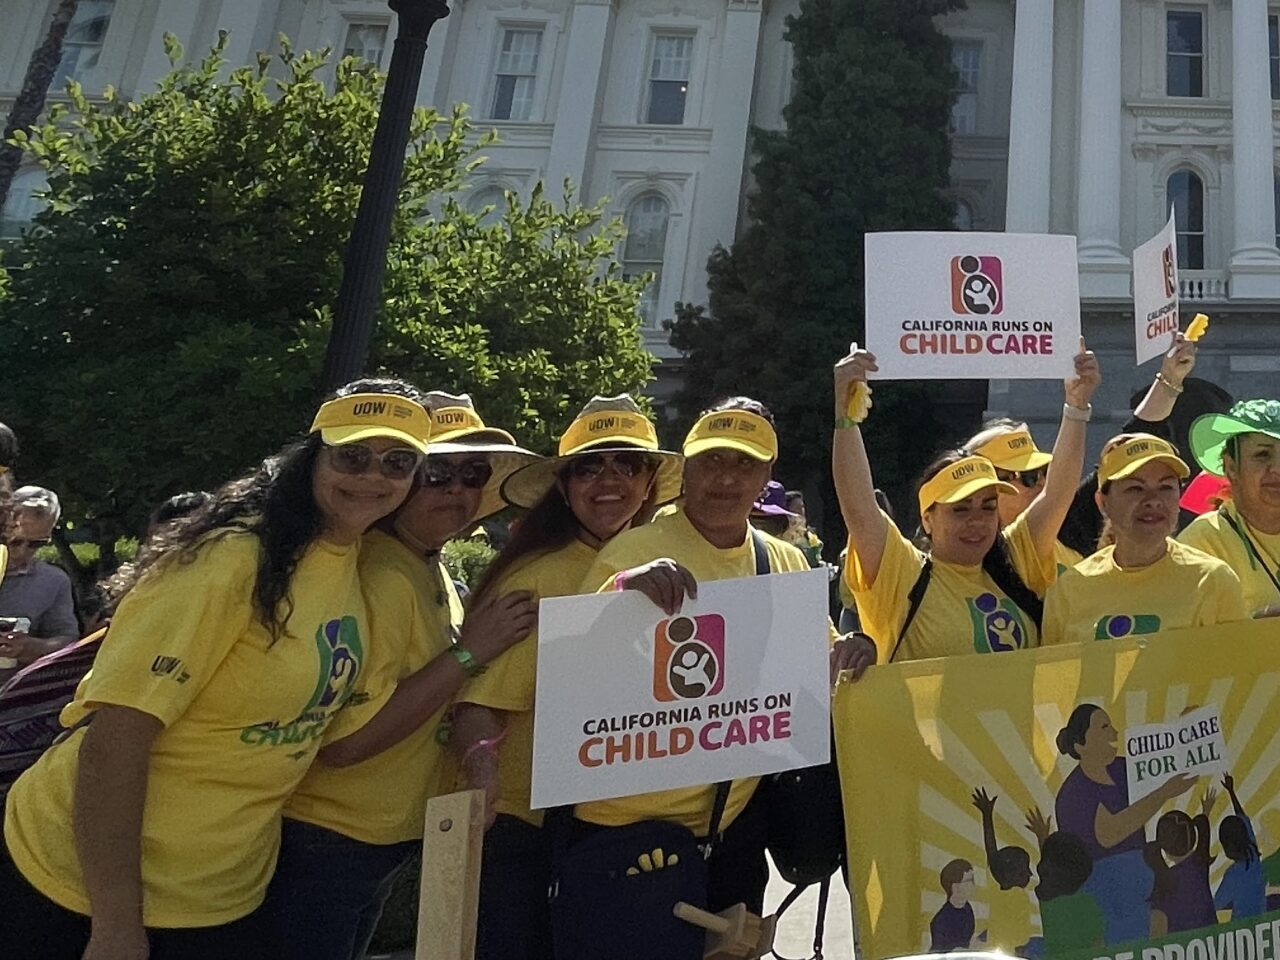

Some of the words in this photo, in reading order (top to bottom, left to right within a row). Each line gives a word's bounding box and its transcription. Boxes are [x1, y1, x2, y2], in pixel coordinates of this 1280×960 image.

[901, 320, 988, 332] CALIFORNIA
[992, 321, 1029, 332] RUNS
[1032, 321, 1053, 332] ON
[353, 401, 387, 416] UDW
[437, 413, 464, 425] UDW
[588, 417, 616, 432] UDW
[708, 417, 734, 431] UDW
[1008, 436, 1029, 450] UDW
[1126, 442, 1150, 456] UDW
[951, 463, 975, 480] UDW
[583, 706, 702, 736] CALIFORNIA
[708, 697, 759, 720] RUNS
[764, 692, 792, 711] ON
[1127, 732, 1175, 757] CHILD
[1178, 716, 1220, 744] CARE
[1134, 755, 1177, 782] FOR
[1185, 742, 1221, 768] ALL
